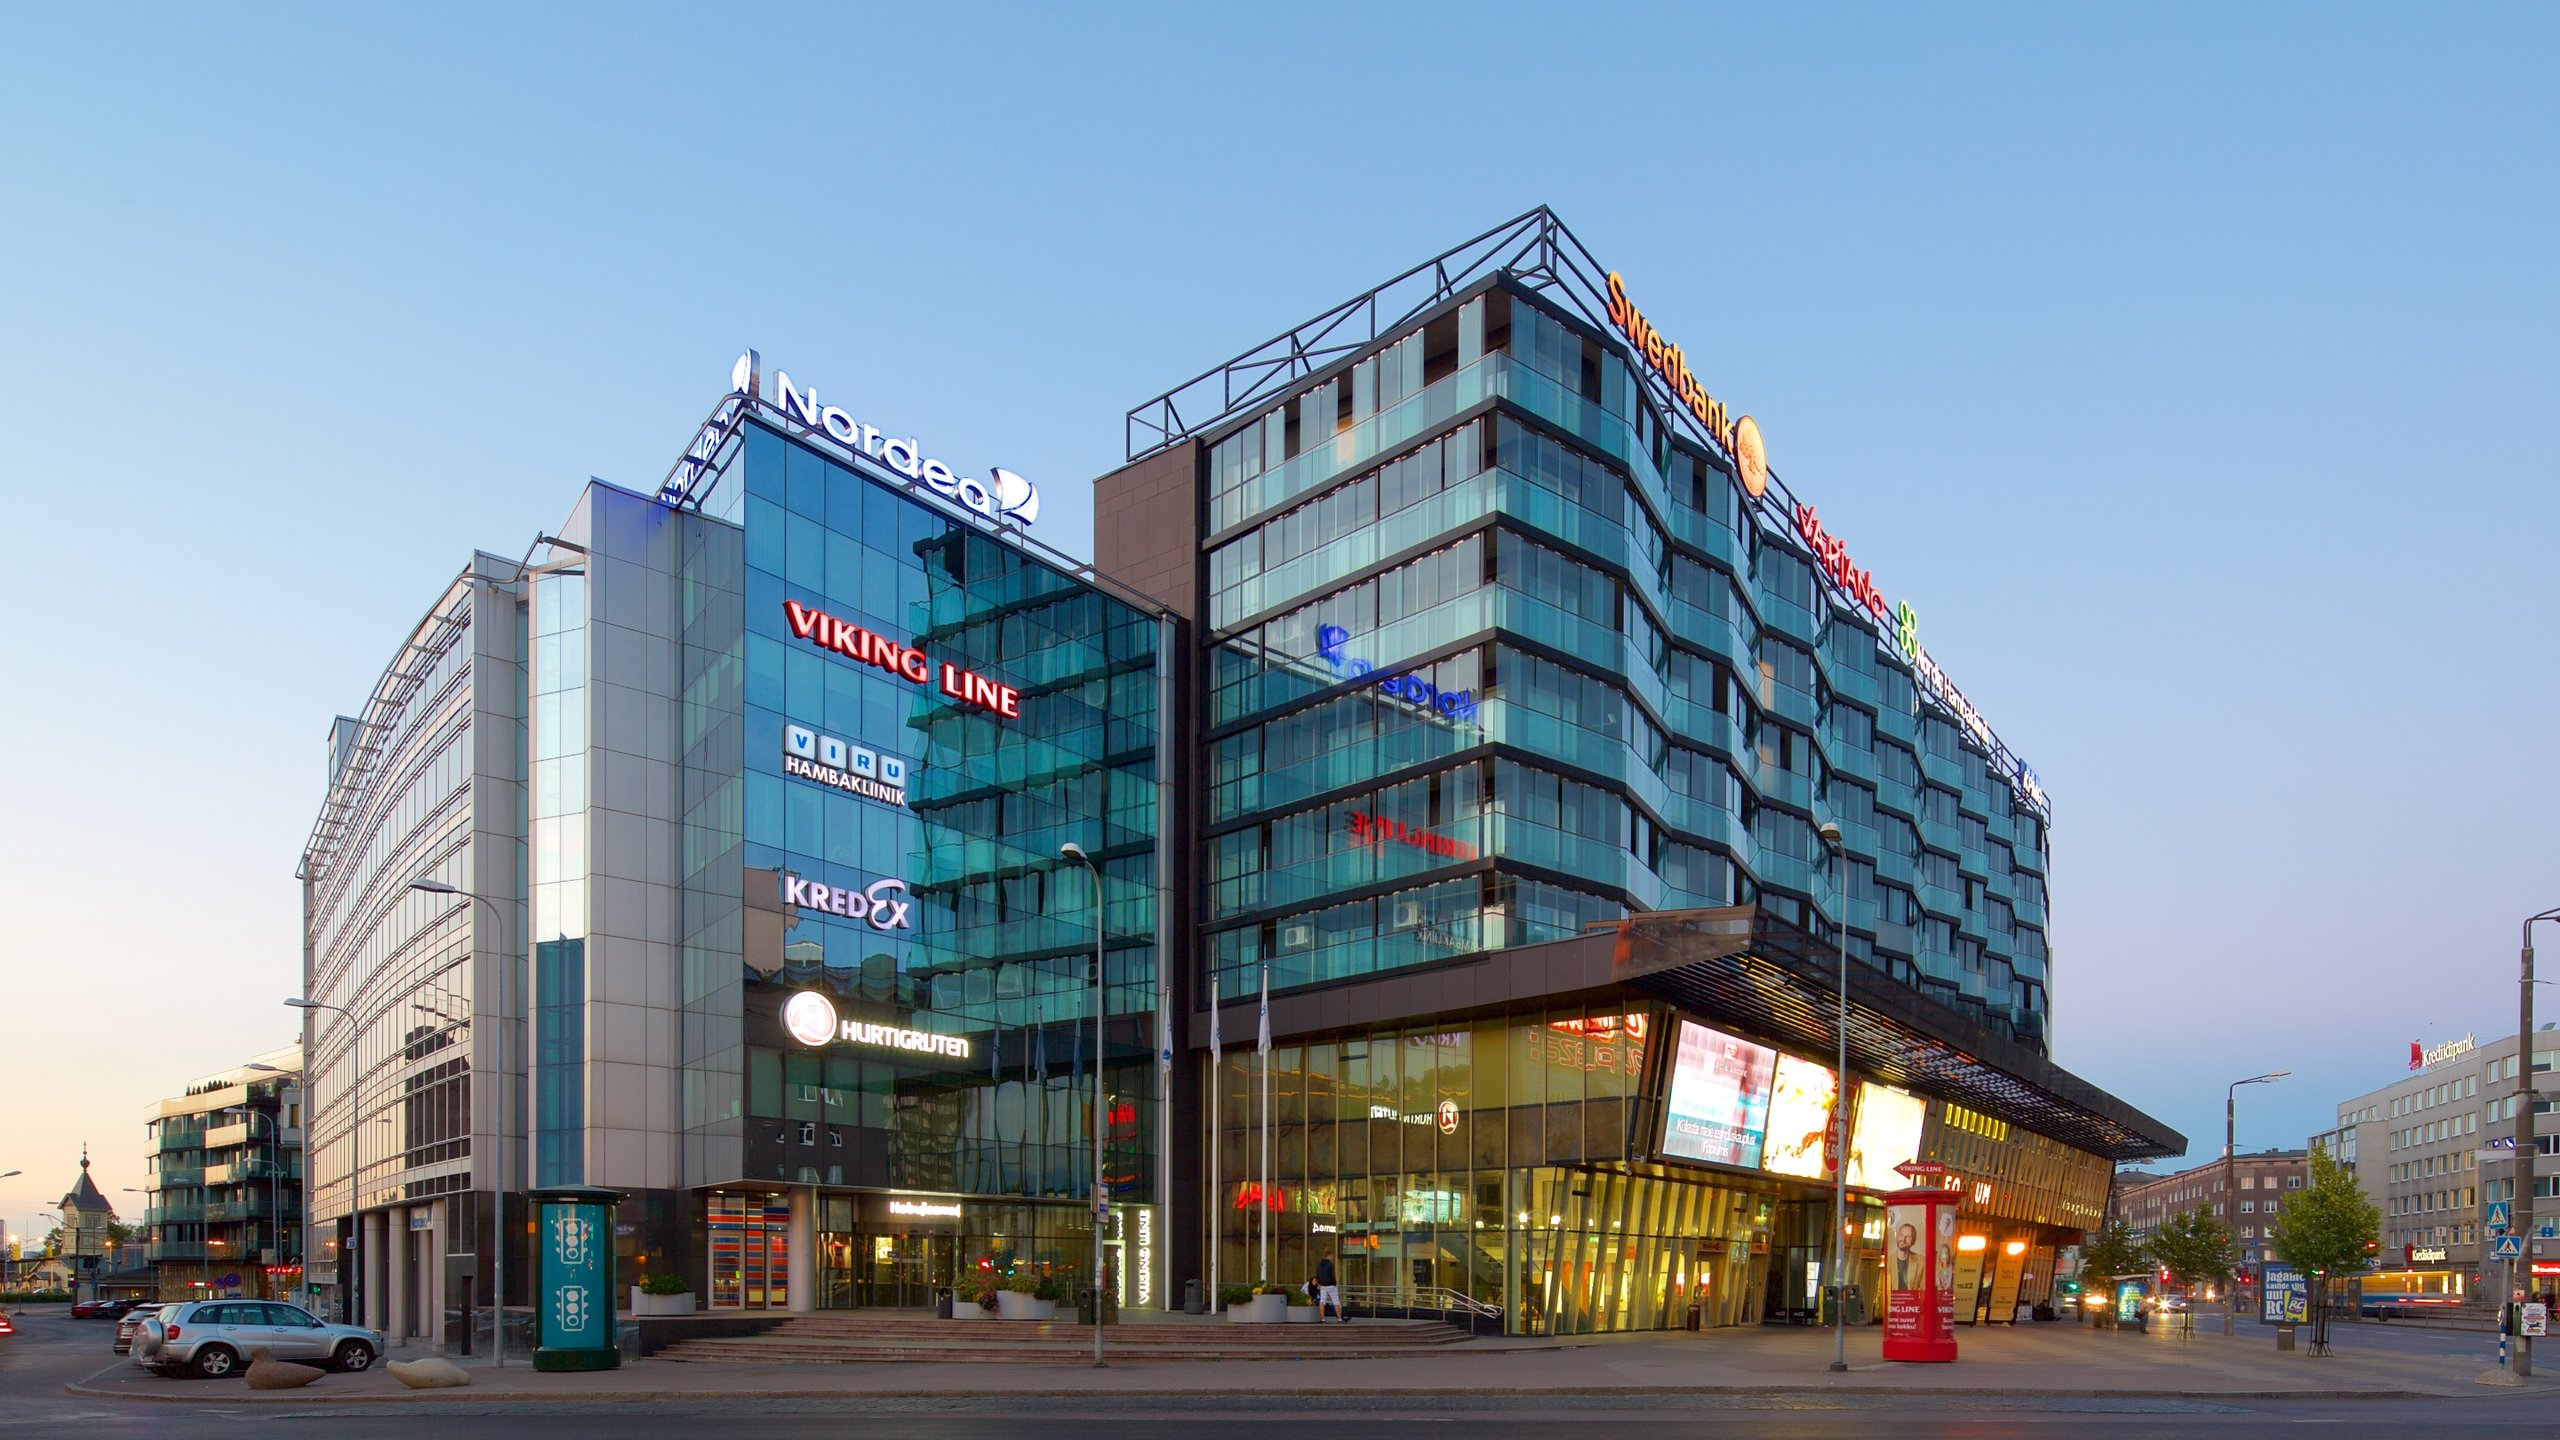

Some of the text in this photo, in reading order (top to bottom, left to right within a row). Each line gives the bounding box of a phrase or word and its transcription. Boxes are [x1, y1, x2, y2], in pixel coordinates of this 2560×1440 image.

[1606, 271, 1735, 454] Swedbank
[774, 369, 991, 516] Nordea
[782, 600, 1019, 718] VIKING LINE
[785, 756, 905, 806] HAMBAKLIINIK
[790, 730, 903, 783] VIRU
[842, 1020, 969, 1058] HURTIGRUTEN
[2423, 1032, 2475, 1066] Krediidipank
[1139, 1247, 1151, 1305] VIKING
[1901, 1305, 1920, 1313] LINE
[2266, 1300, 2283, 1314] RC
